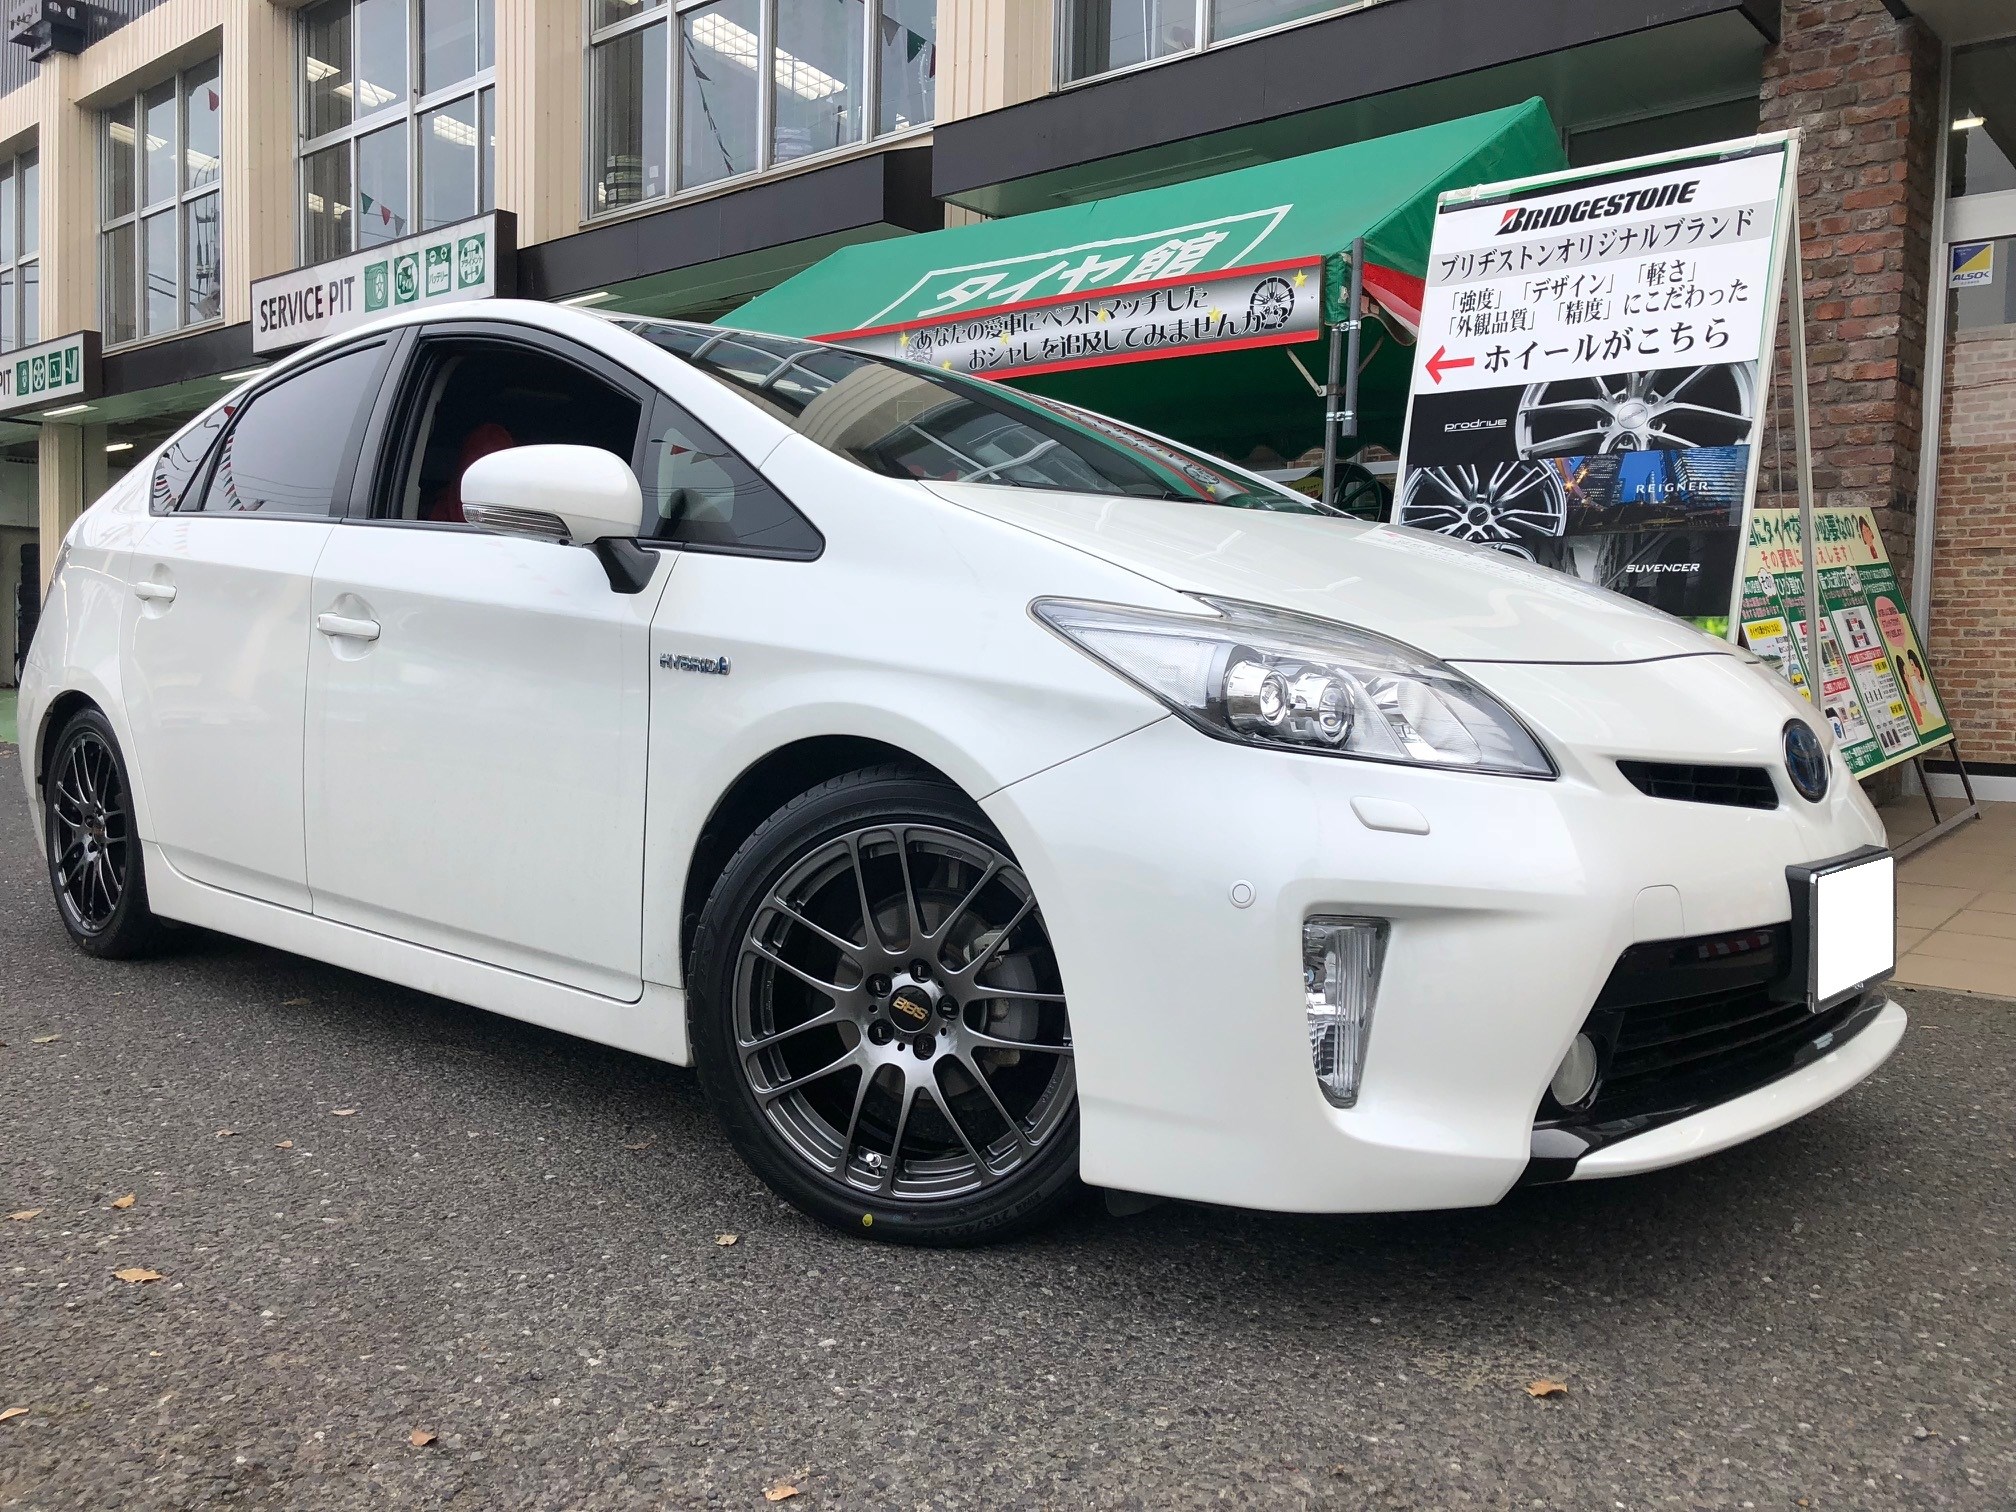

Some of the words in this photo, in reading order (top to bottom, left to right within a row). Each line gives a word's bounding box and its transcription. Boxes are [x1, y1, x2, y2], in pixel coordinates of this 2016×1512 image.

[1494, 180, 1701, 236] BRIDGESTONE
[1441, 208, 1755, 282] ブリヂストンオリジナルブランド
[917, 231, 1230, 318] タイヤ館
[1953, 271, 1990, 282] ALSOK
[260, 284, 324, 333] SERVICE
[329, 276, 355, 316] PIT
[916, 286, 1209, 350] あなたの愛車にベストマッチした
[1483, 317, 1731, 374] ホイールがこちら
[0, 368, 12, 396] IT
[1636, 481, 1709, 494] REIGNER
[1626, 563, 1700, 573] SUVENCER
[892, 995, 929, 1020] BBS
